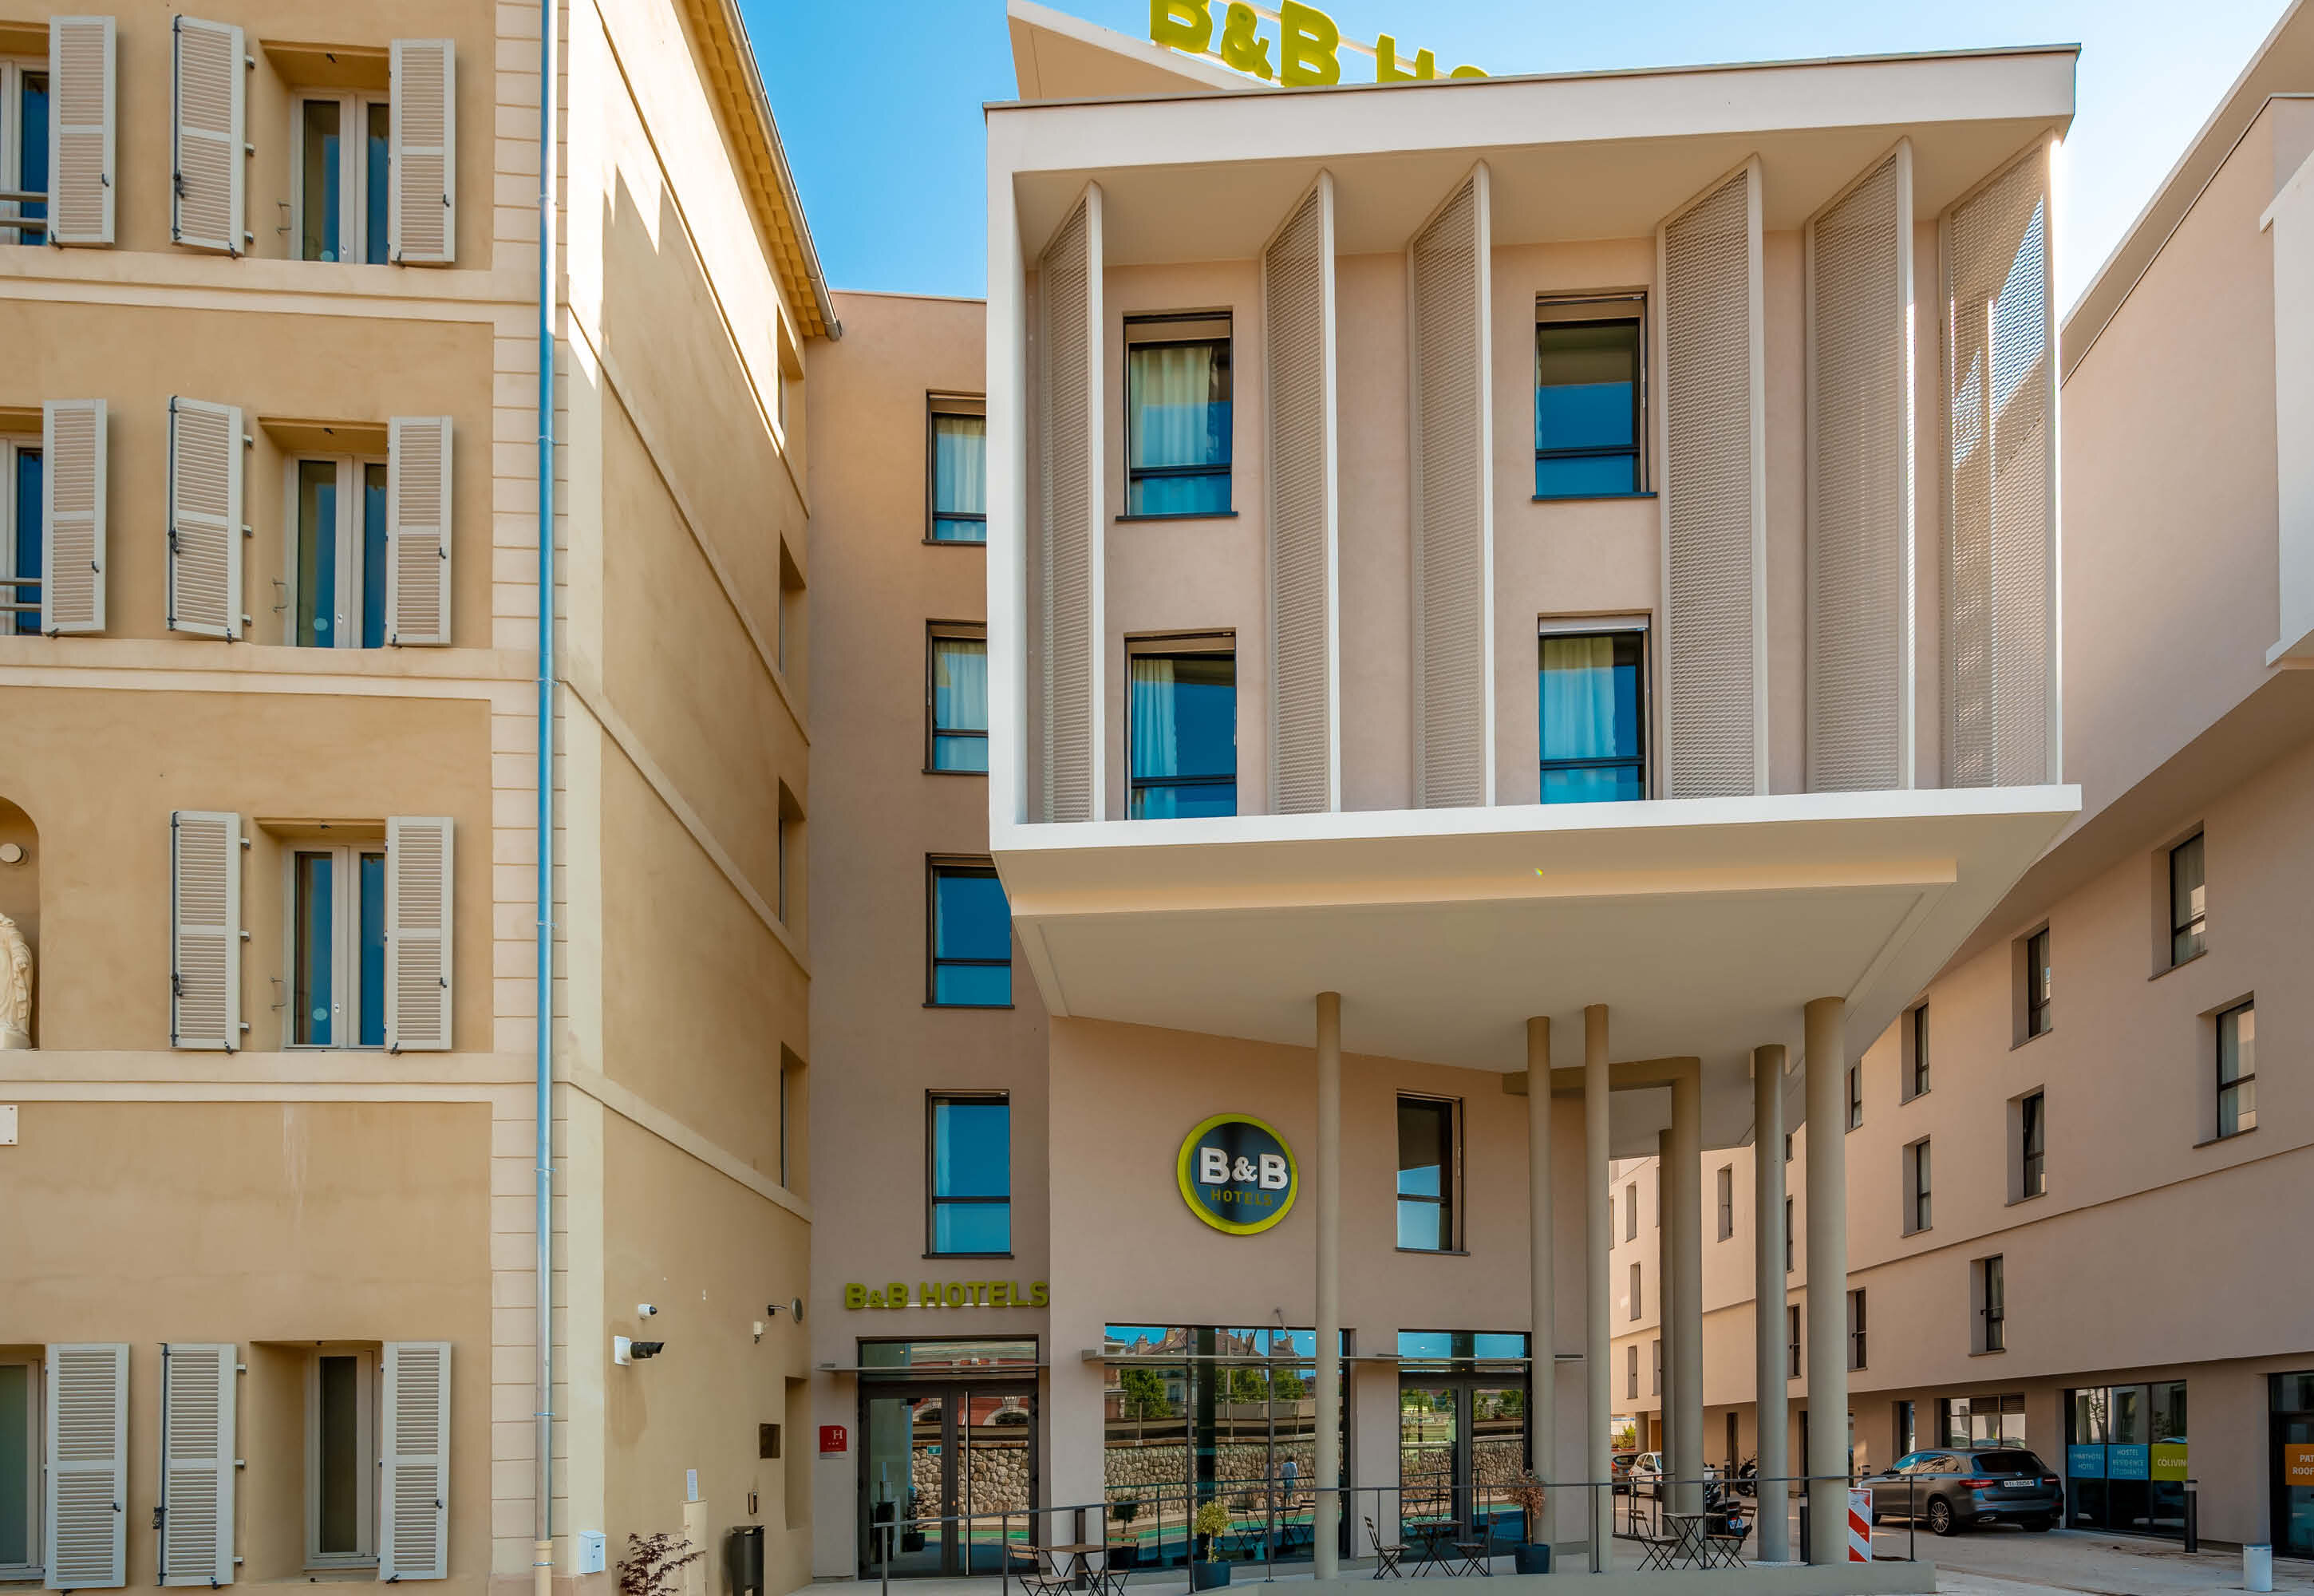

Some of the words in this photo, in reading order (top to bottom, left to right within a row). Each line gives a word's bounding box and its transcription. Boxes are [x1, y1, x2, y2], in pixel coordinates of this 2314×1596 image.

[1150, 0, 1341, 87] B&B
[1200, 1148, 1289, 1190] B&B
[1210, 1187, 1273, 1207] HOTELS
[845, 1282, 909, 1309] B&B
[919, 1281, 1049, 1308] HOTELS
[832, 1430, 843, 1440] H
